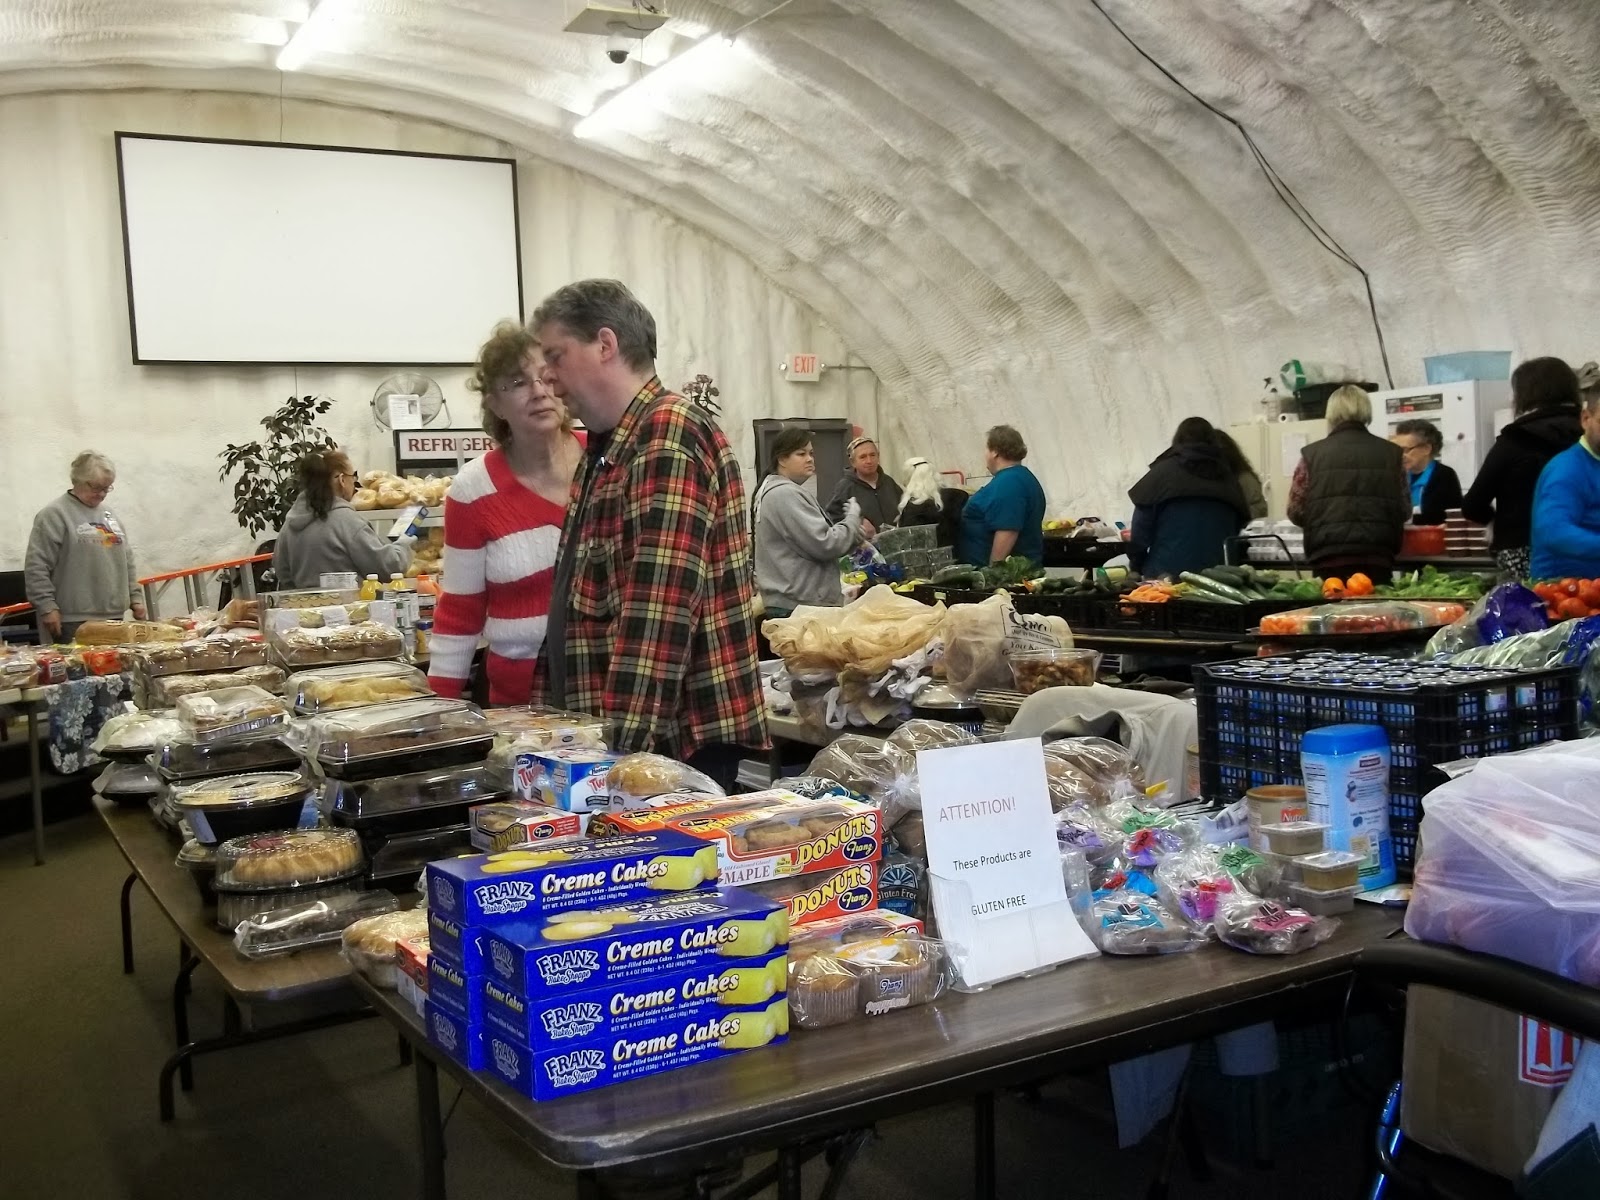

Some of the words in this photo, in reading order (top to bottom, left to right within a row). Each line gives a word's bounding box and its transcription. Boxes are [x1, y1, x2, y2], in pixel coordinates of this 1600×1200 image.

[794, 355, 816, 373] EXIT
[939, 796, 1016, 823] ATTENTION!
[798, 813, 877, 865] DONUTS
[846, 840, 874, 857] Franz
[953, 859, 979, 871] These
[981, 851, 1017, 866] Products
[1019, 849, 1032, 859] are
[541, 869, 606, 895] Creme
[611, 859, 669, 885] Cakes
[725, 865, 772, 885] MAPLE
[475, 881, 534, 907] FRANZ
[575, 889, 591, 898] Golden
[791, 865, 872, 917] DONUTS
[842, 892, 869, 909] Franz
[971, 900, 1005, 916] GLUTEN
[1006, 894, 1027, 908] FREE
[607, 940, 674, 963] Creme
[680, 924, 739, 950] Cakes
[537, 951, 599, 978] FRANZ
[642, 958, 658, 966] Golden
[609, 987, 676, 1015] Creme
[682, 974, 740, 999] Cakes
[541, 1003, 602, 1031] FRANZ
[645, 1009, 661, 1017] Golden
[611, 1033, 678, 1062] Creme
[683, 1018, 741, 1045] Cakes
[544, 1051, 606, 1079] FRANZ
[646, 1057, 662, 1065] Golden
